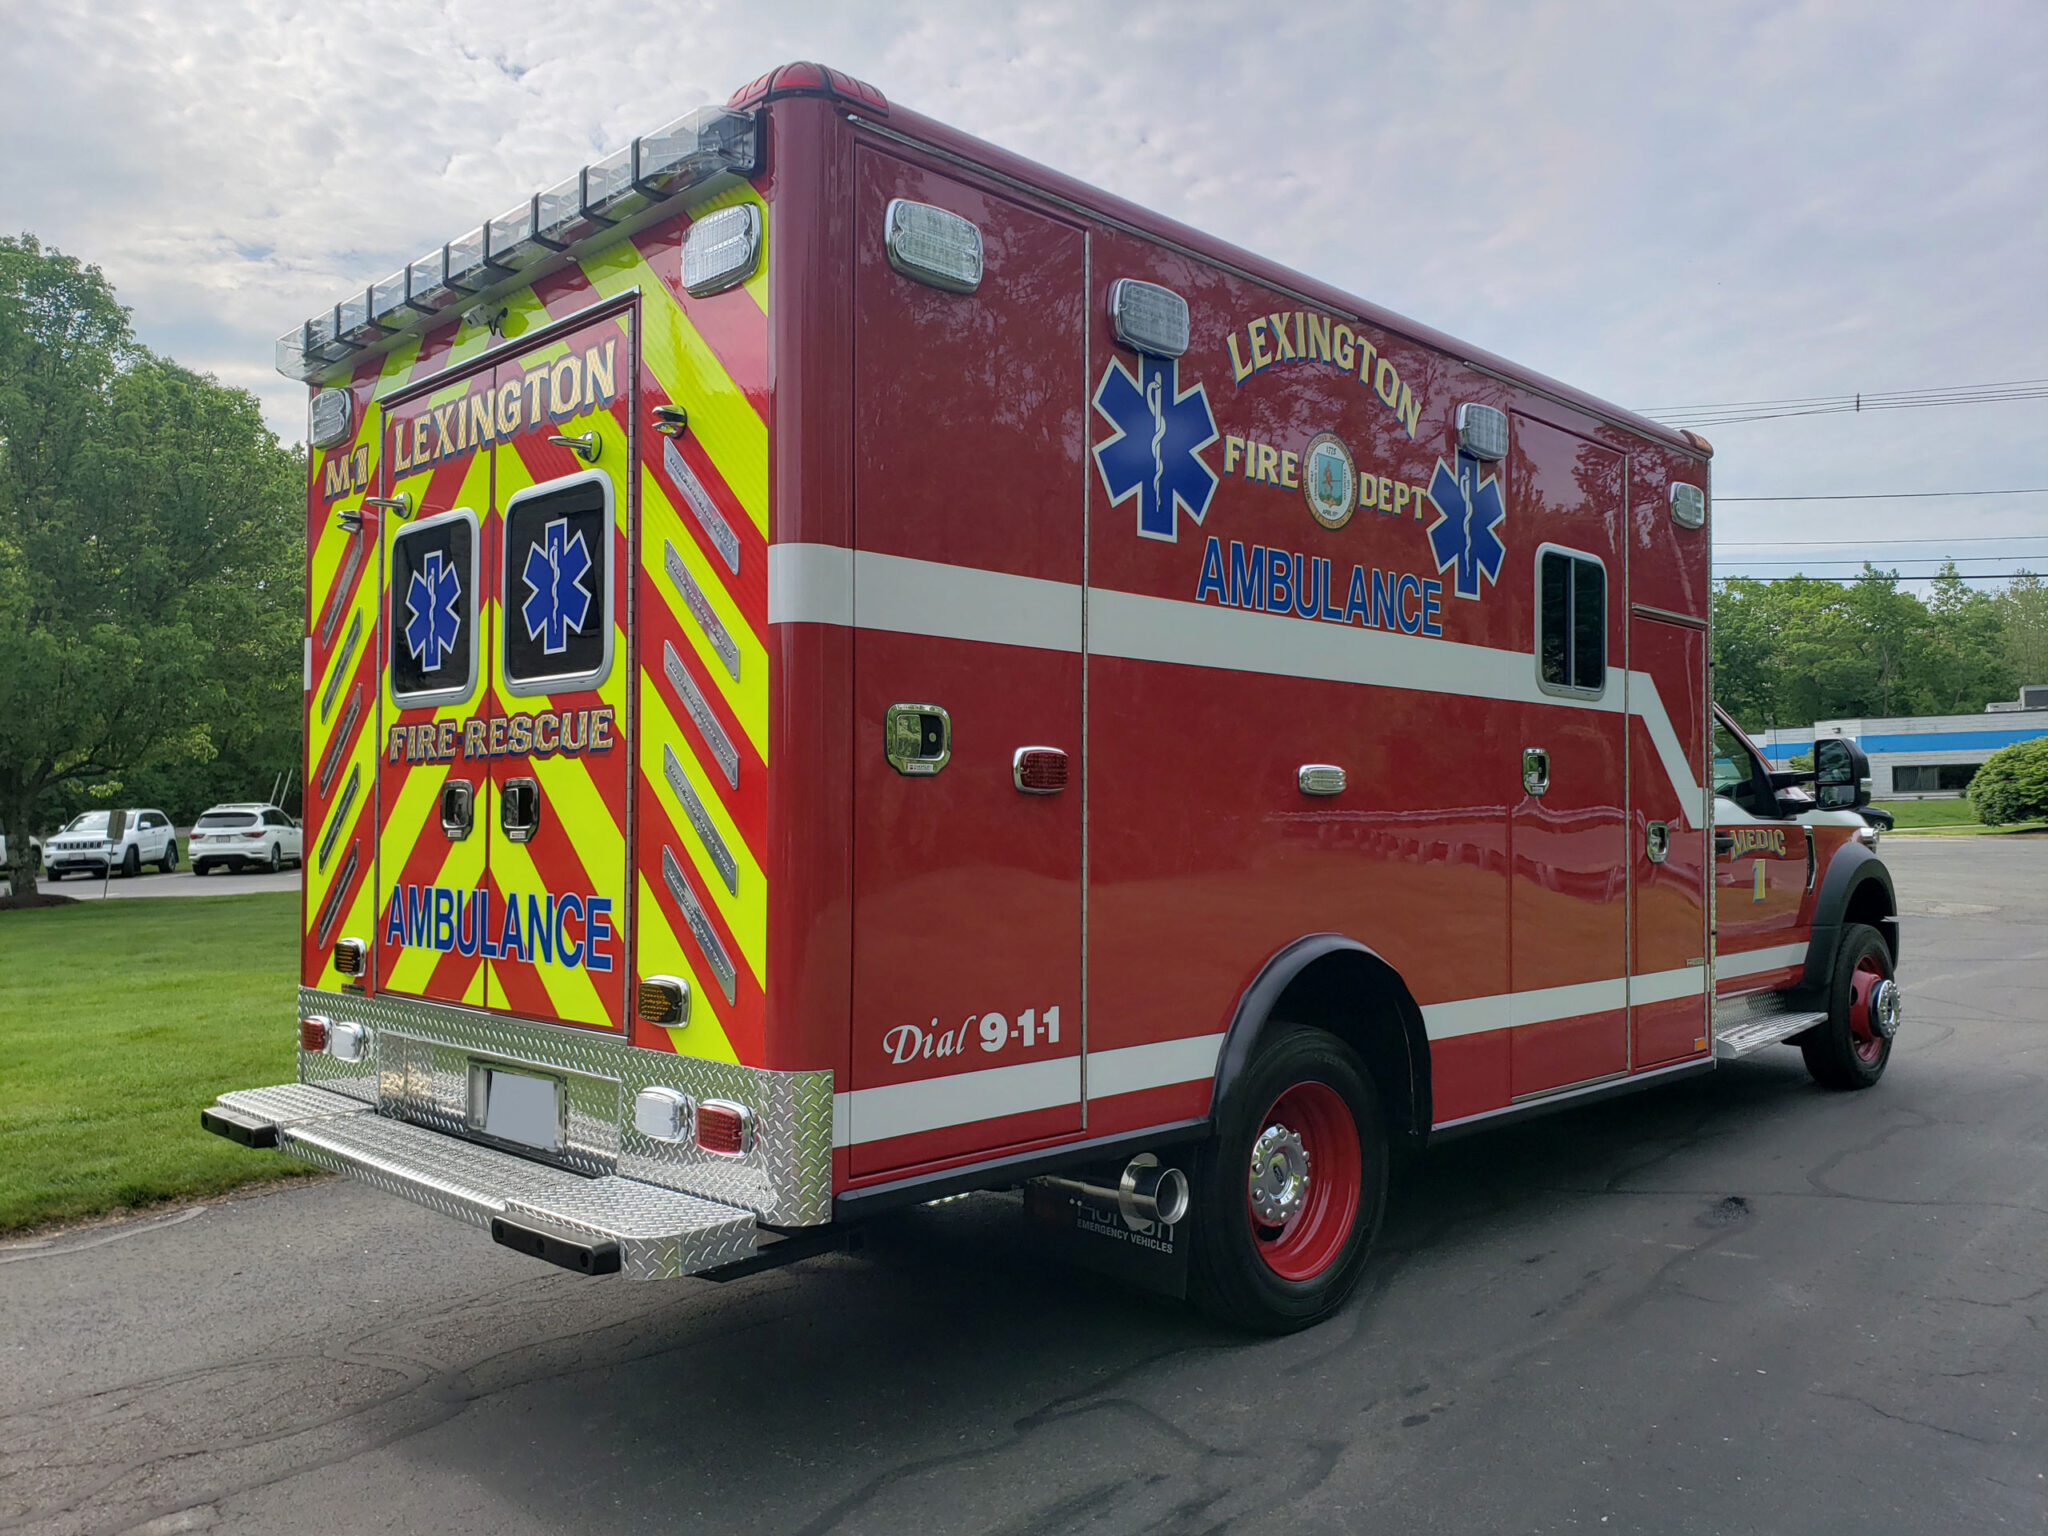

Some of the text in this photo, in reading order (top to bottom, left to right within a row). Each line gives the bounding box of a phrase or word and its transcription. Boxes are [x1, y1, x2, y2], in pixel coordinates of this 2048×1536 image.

[394, 339, 616, 475] LEXINGTON
[1226, 312, 1422, 438] LEXINGTON
[1224, 435, 1299, 490] FIRE
[1358, 473, 1428, 520] DEPT
[1196, 536, 1442, 637] AMBULANCE
[1730, 829, 1786, 861] MEDIC
[1752, 859, 1766, 904] 1
[386, 884, 612, 972] AMBULANCE
[882, 1005, 1060, 1065] Dial 9-1-1
[1077, 1217, 1174, 1255] EMERGENCY VEHICLES
